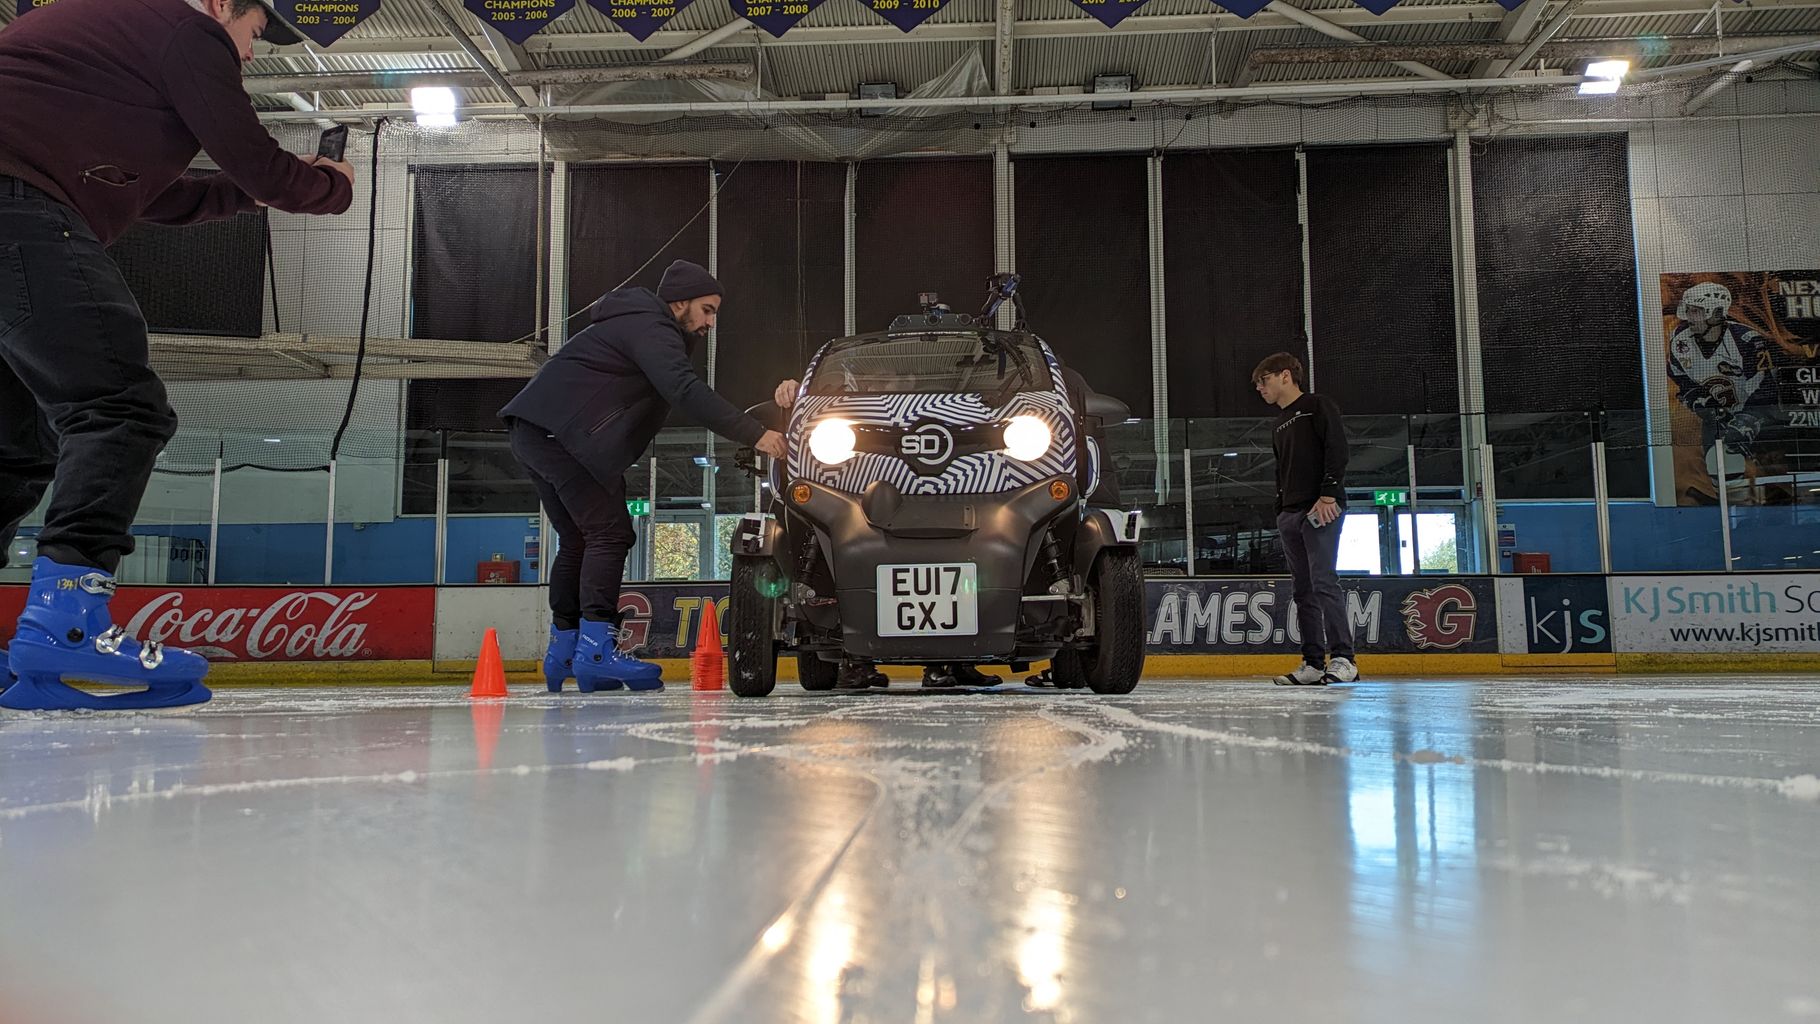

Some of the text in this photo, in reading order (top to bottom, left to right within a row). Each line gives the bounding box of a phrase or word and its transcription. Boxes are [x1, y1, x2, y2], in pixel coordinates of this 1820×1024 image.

[295, 3, 359, 13] CHAMPIONS
[484, 0, 556, 9] CHAMPIONS
[747, 5, 772, 16] 2007
[783, 4, 809, 15] 2008
[873, 0, 900, 9] 2009
[913, 0, 940, 9] 2010
[491, 12, 516, 20] 2005
[525, 10, 548, 20] 2006
[611, 8, 637, 18] 2006
[651, 7, 676, 17] 2007
[296, 15, 320, 24] 2003
[333, 16, 356, 25] 2004
[1788, 412, 1820, 427] 22N
[901, 434, 940, 455] SD
[892, 567, 961, 596] EU17
[897, 601, 958, 630] GXJ
[123, 590, 378, 658] Coca-Cola
[1530, 596, 1606, 654] kjs
